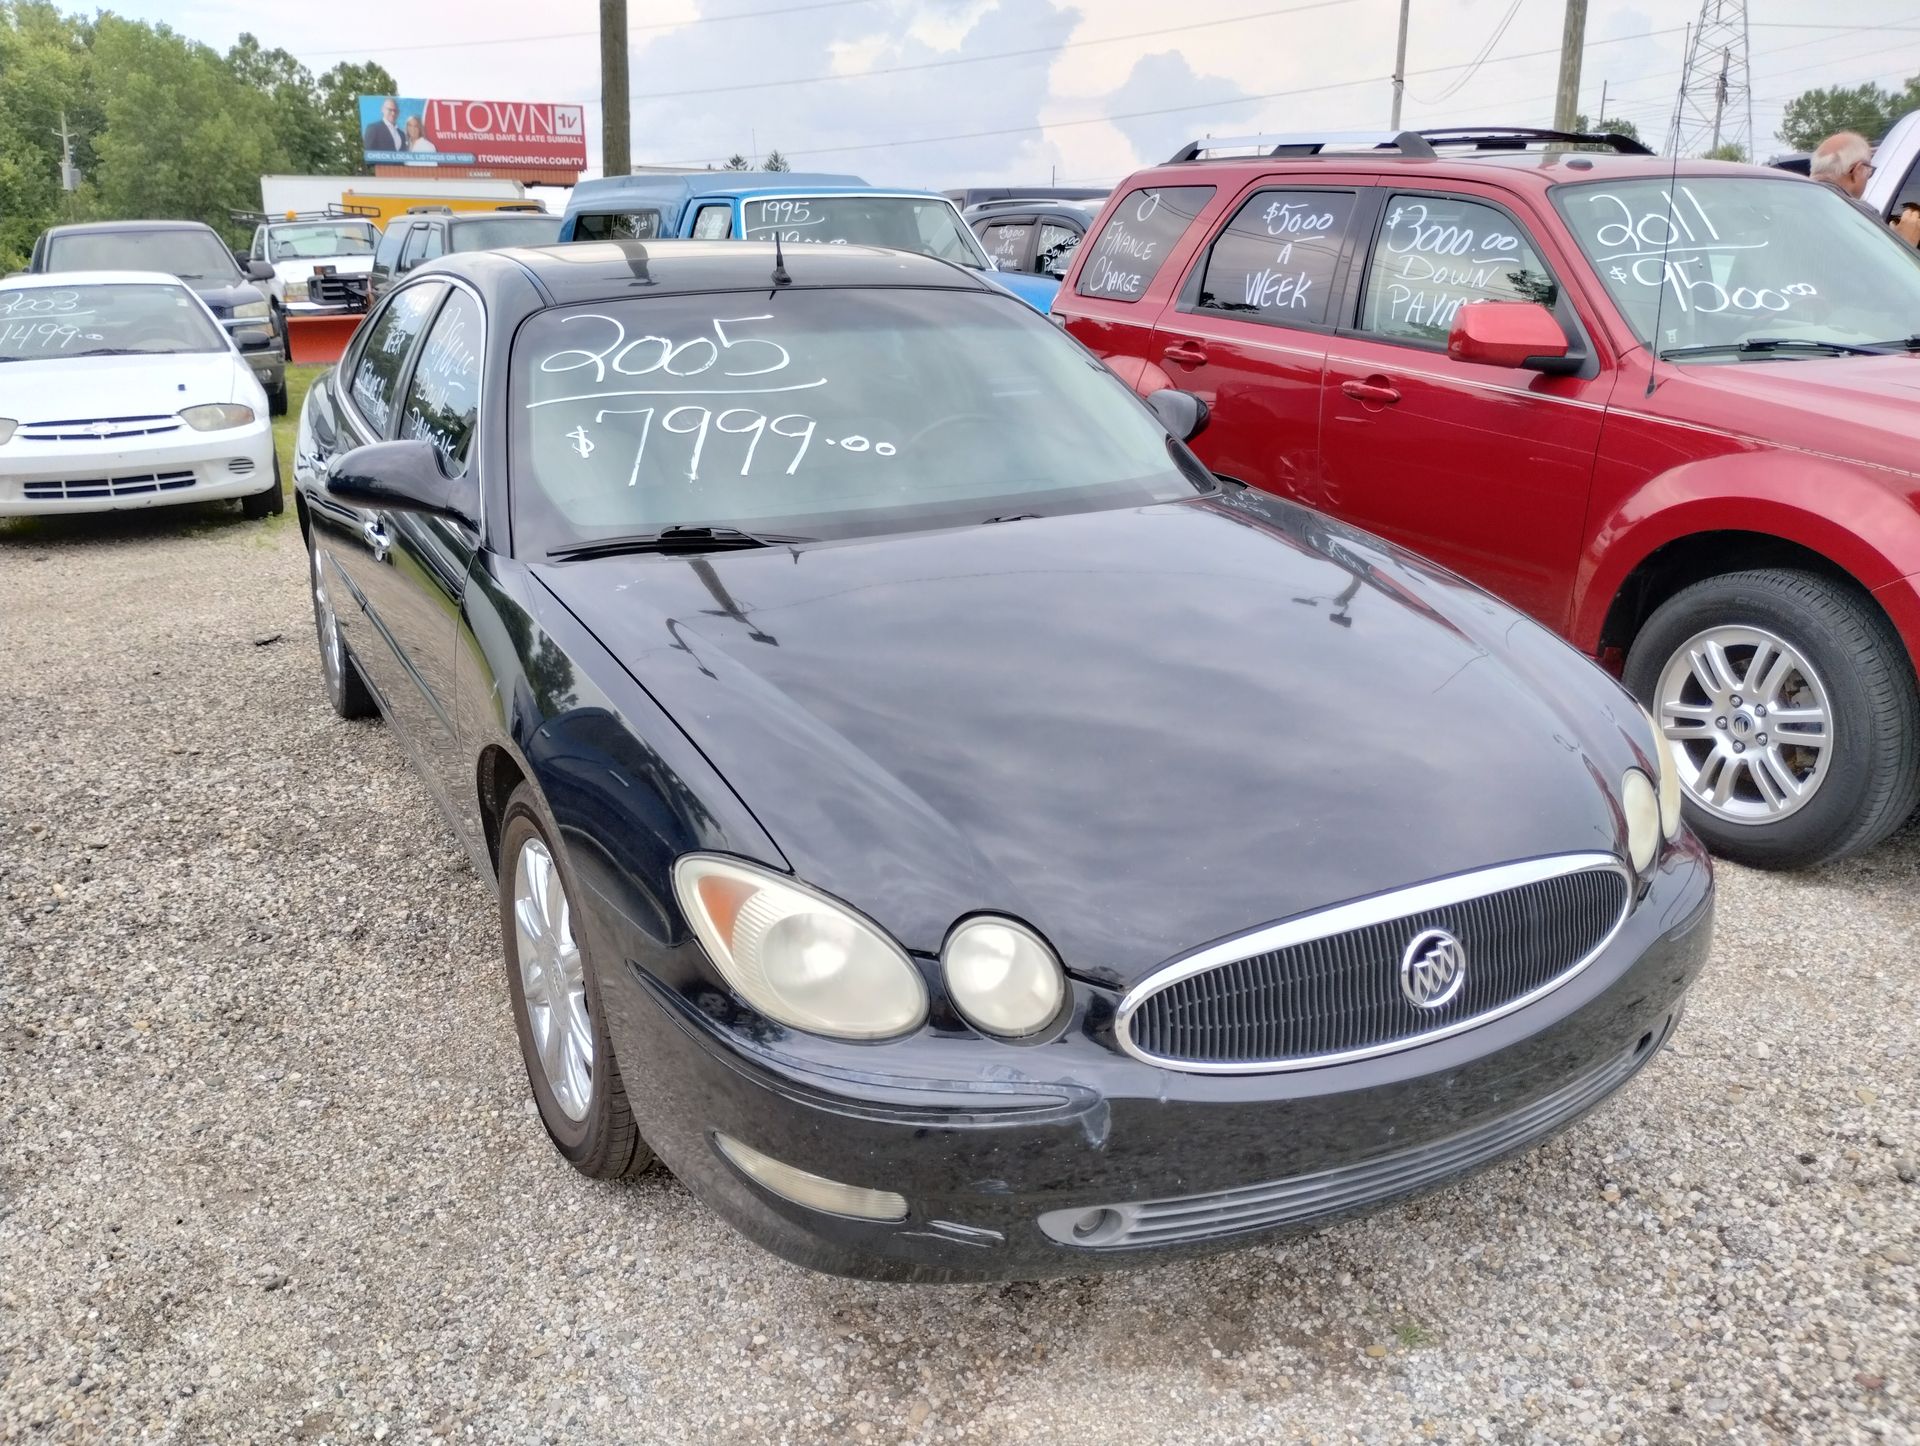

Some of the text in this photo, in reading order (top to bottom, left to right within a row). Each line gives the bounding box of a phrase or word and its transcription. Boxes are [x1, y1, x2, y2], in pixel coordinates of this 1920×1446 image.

[432, 101, 554, 134] ITOWN
[436, 131, 457, 140] WITH
[458, 133, 494, 142] PASTORS
[495, 134, 516, 142] DAVE
[525, 135, 546, 143] KATE
[547, 136, 583, 144] SUMRALL
[478, 154, 584, 166] ITOWNCHURCH.COM/TV
[761, 201, 811, 223] 1995
[1588, 187, 1720, 251] 2011
[1386, 204, 1519, 255] $3000.00
[1276, 243, 1294, 265] A
[1394, 254, 1499, 288] DOWN
[0, 290, 79, 314] 2003
[1245, 268, 1312, 308] WEEK
[1387, 284, 1485, 326] PAYM
[541, 313, 791, 383] 2005
[566, 406, 897, 488] $7999.00
